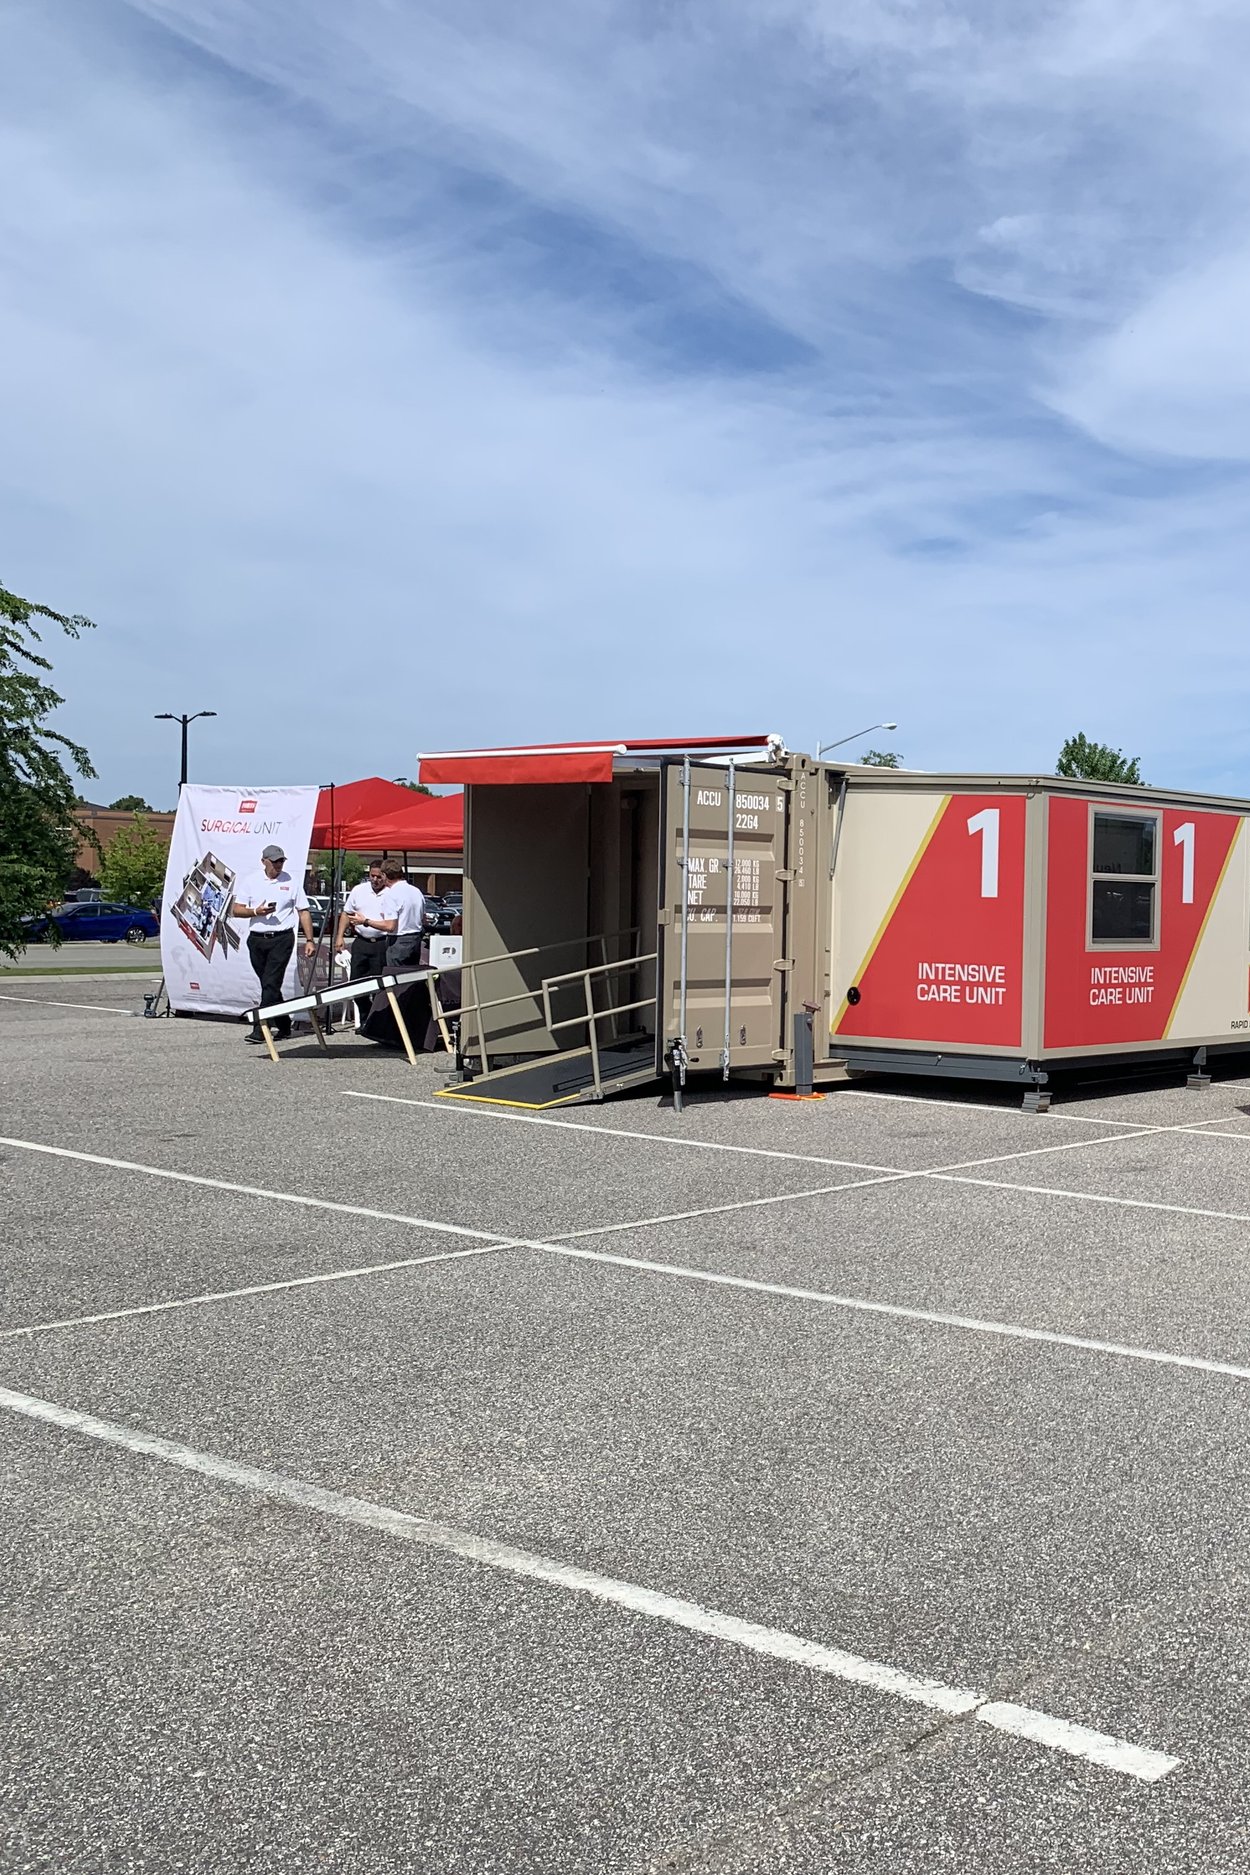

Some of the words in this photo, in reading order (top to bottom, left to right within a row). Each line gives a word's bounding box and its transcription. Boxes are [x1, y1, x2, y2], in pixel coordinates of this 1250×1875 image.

[697, 790, 721, 806] ACCU
[736, 794, 769, 811] 850034
[776, 796, 784, 811] 5
[201, 819, 251, 834] SURGICAL
[253, 821, 283, 834] UNIT
[736, 813, 758, 829] 22G4
[967, 808, 1000, 898] 1
[708, 858, 722, 874] GR.
[1173, 822, 1196, 904] 1
[688, 874, 707, 889] TARE
[687, 890, 703, 905] NET
[918, 962, 1006, 983] INTENSIVE
[1091, 966, 1155, 984] INTENSIVE
[916, 983, 961, 1003] CARE
[965, 986, 1007, 1005] UNIT
[1089, 988, 1123, 1006] CARE
[1126, 986, 1155, 1004] UNIT
[1230, 1020, 1248, 1030] RAPID
